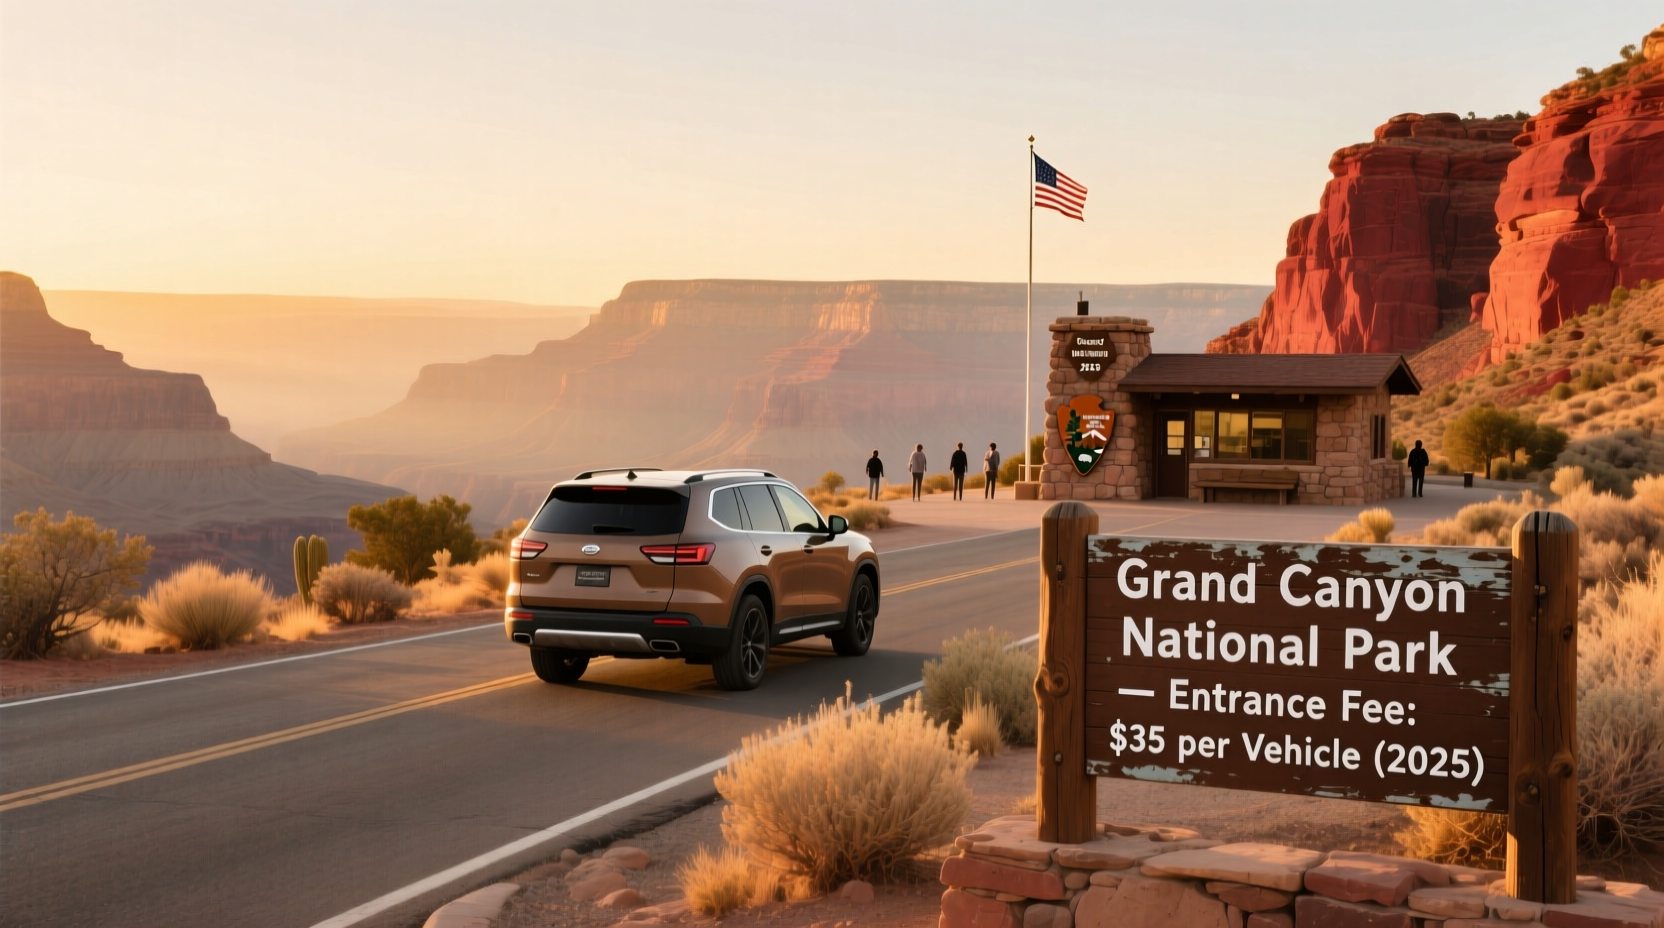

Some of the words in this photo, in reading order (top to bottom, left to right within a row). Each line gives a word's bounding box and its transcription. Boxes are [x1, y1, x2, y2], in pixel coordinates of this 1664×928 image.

[1117, 557, 1256, 604] Grand
[1280, 563, 1465, 622] Canyon
[1123, 616, 1318, 667] National
[1344, 628, 1457, 676] Park
[1170, 679, 1326, 720] Entrance
[1342, 690, 1415, 726] Fee:
[1109, 718, 1165, 756] $35
[1179, 734, 1230, 763] per
[1242, 732, 1361, 770] Vehicle
[1375, 740, 1484, 787] (2025)
